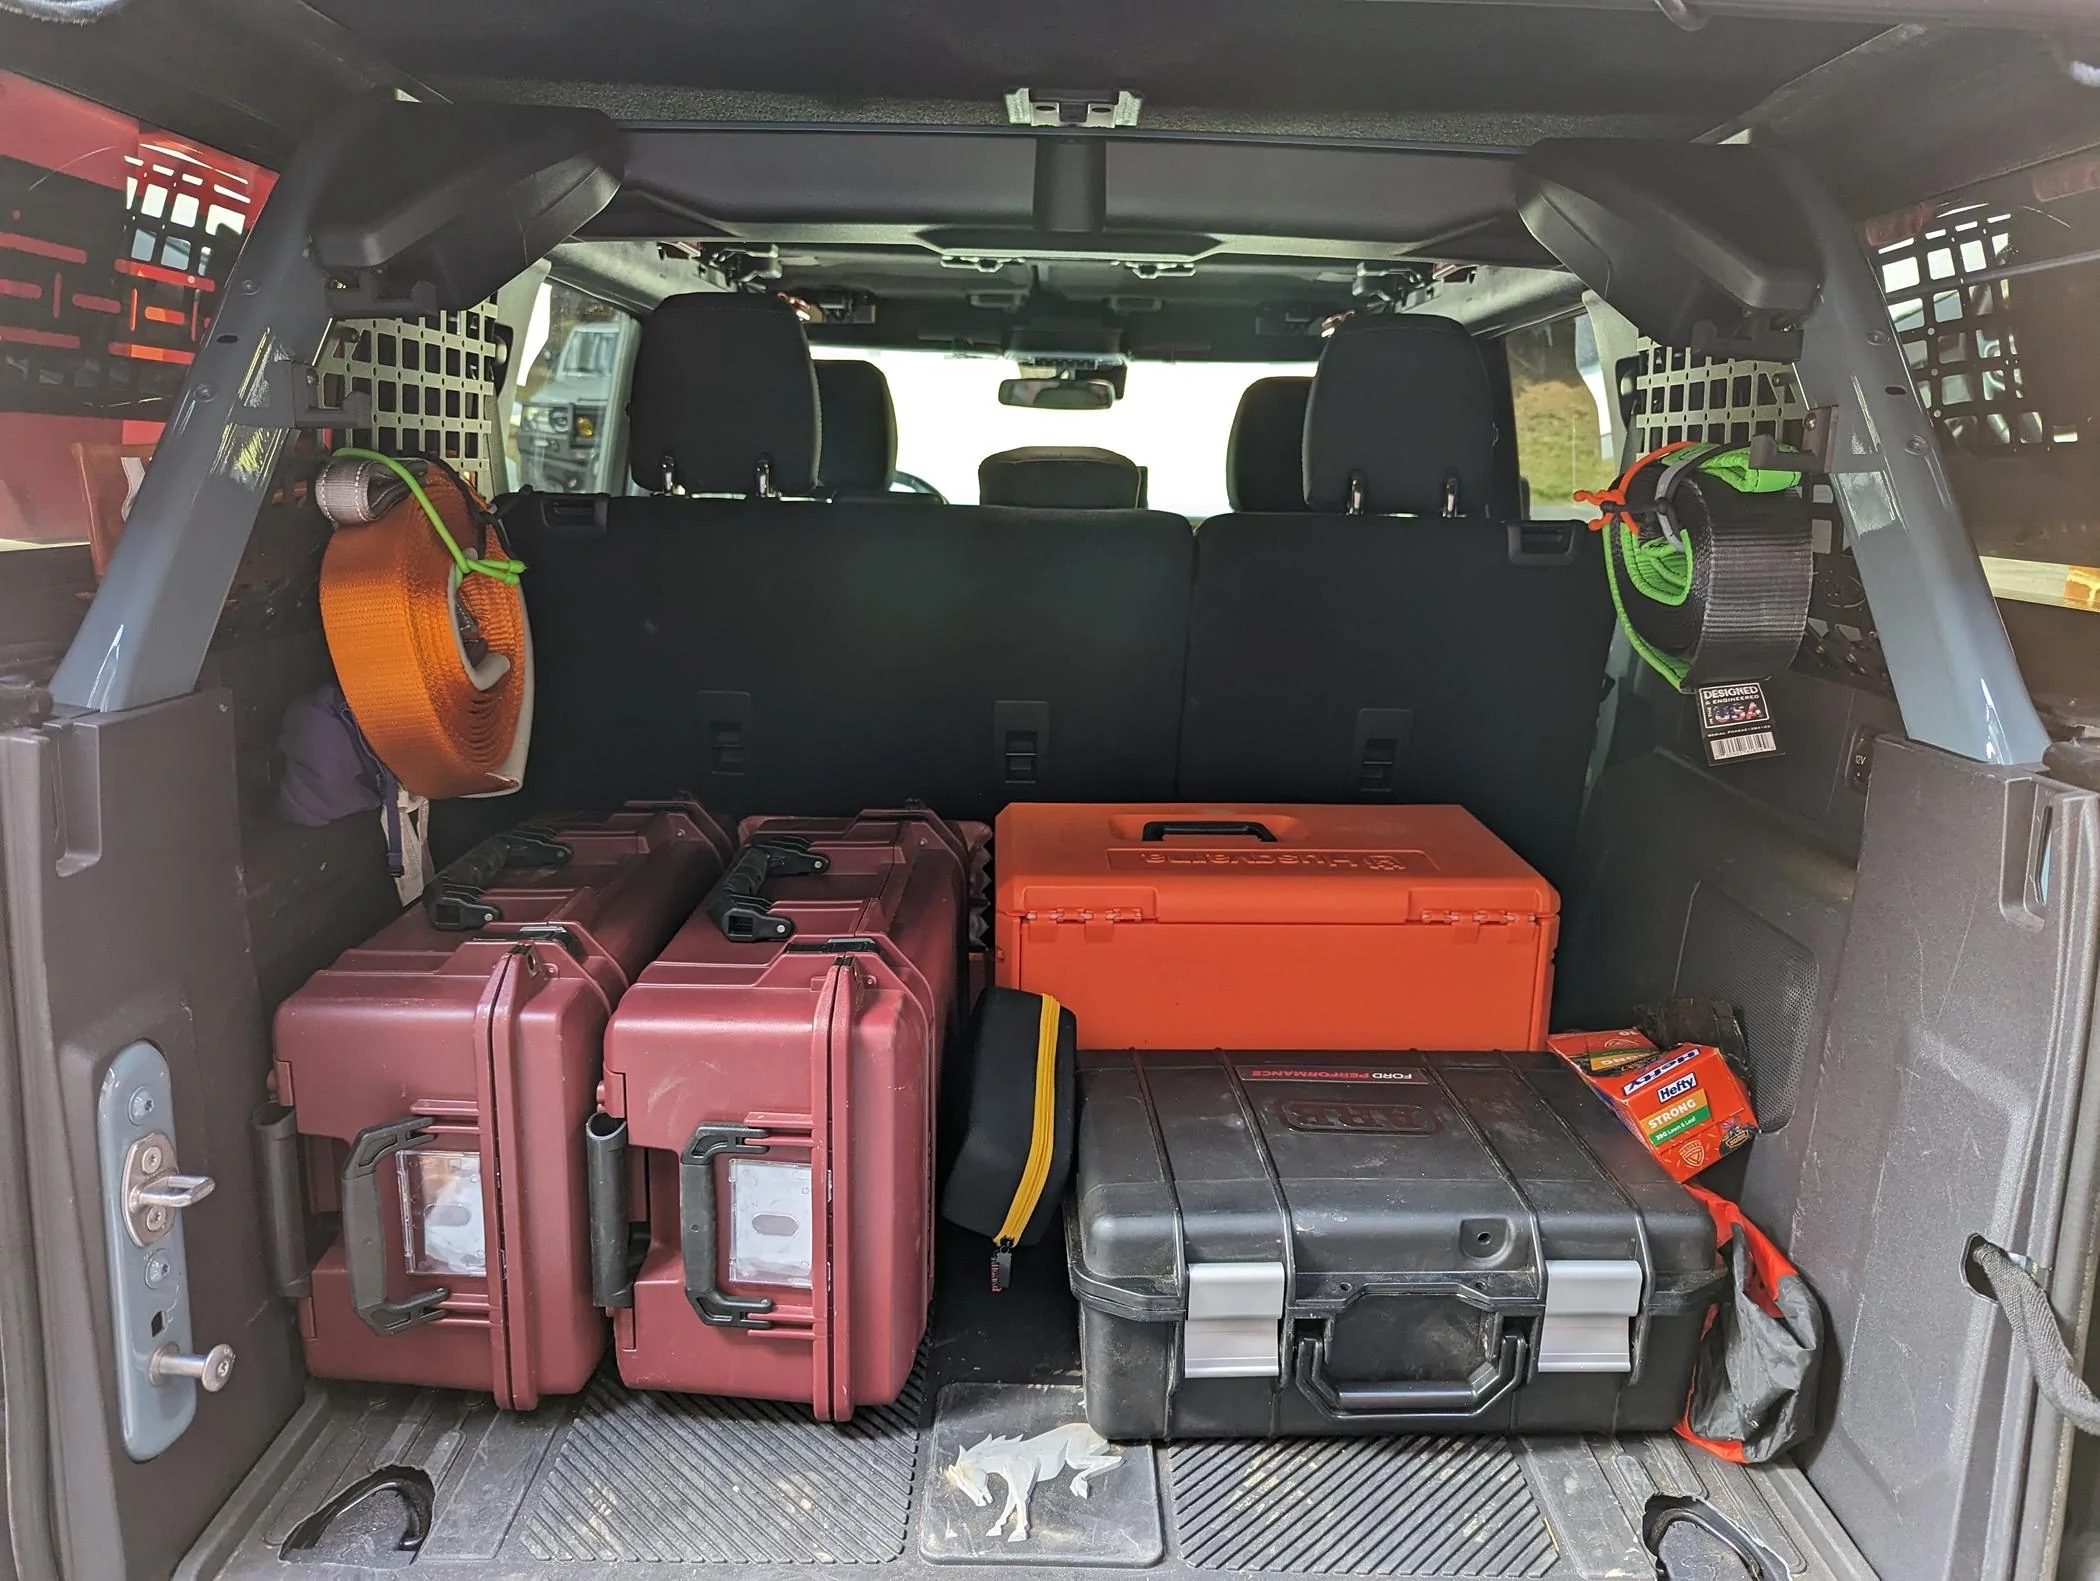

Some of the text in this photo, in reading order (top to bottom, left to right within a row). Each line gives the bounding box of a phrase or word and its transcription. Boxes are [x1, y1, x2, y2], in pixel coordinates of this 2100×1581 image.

[1703, 686, 1759, 700] DESIGNED
[1712, 694, 1760, 705] ENGINEERED
[1713, 702, 1763, 723] USA
[1251, 1070, 1413, 1080] FORD PERFORMANCE
[1628, 1051, 1696, 1092] Hefty
[1660, 1077, 1694, 1100] Hefty
[1648, 1098, 1697, 1129] STRONG
